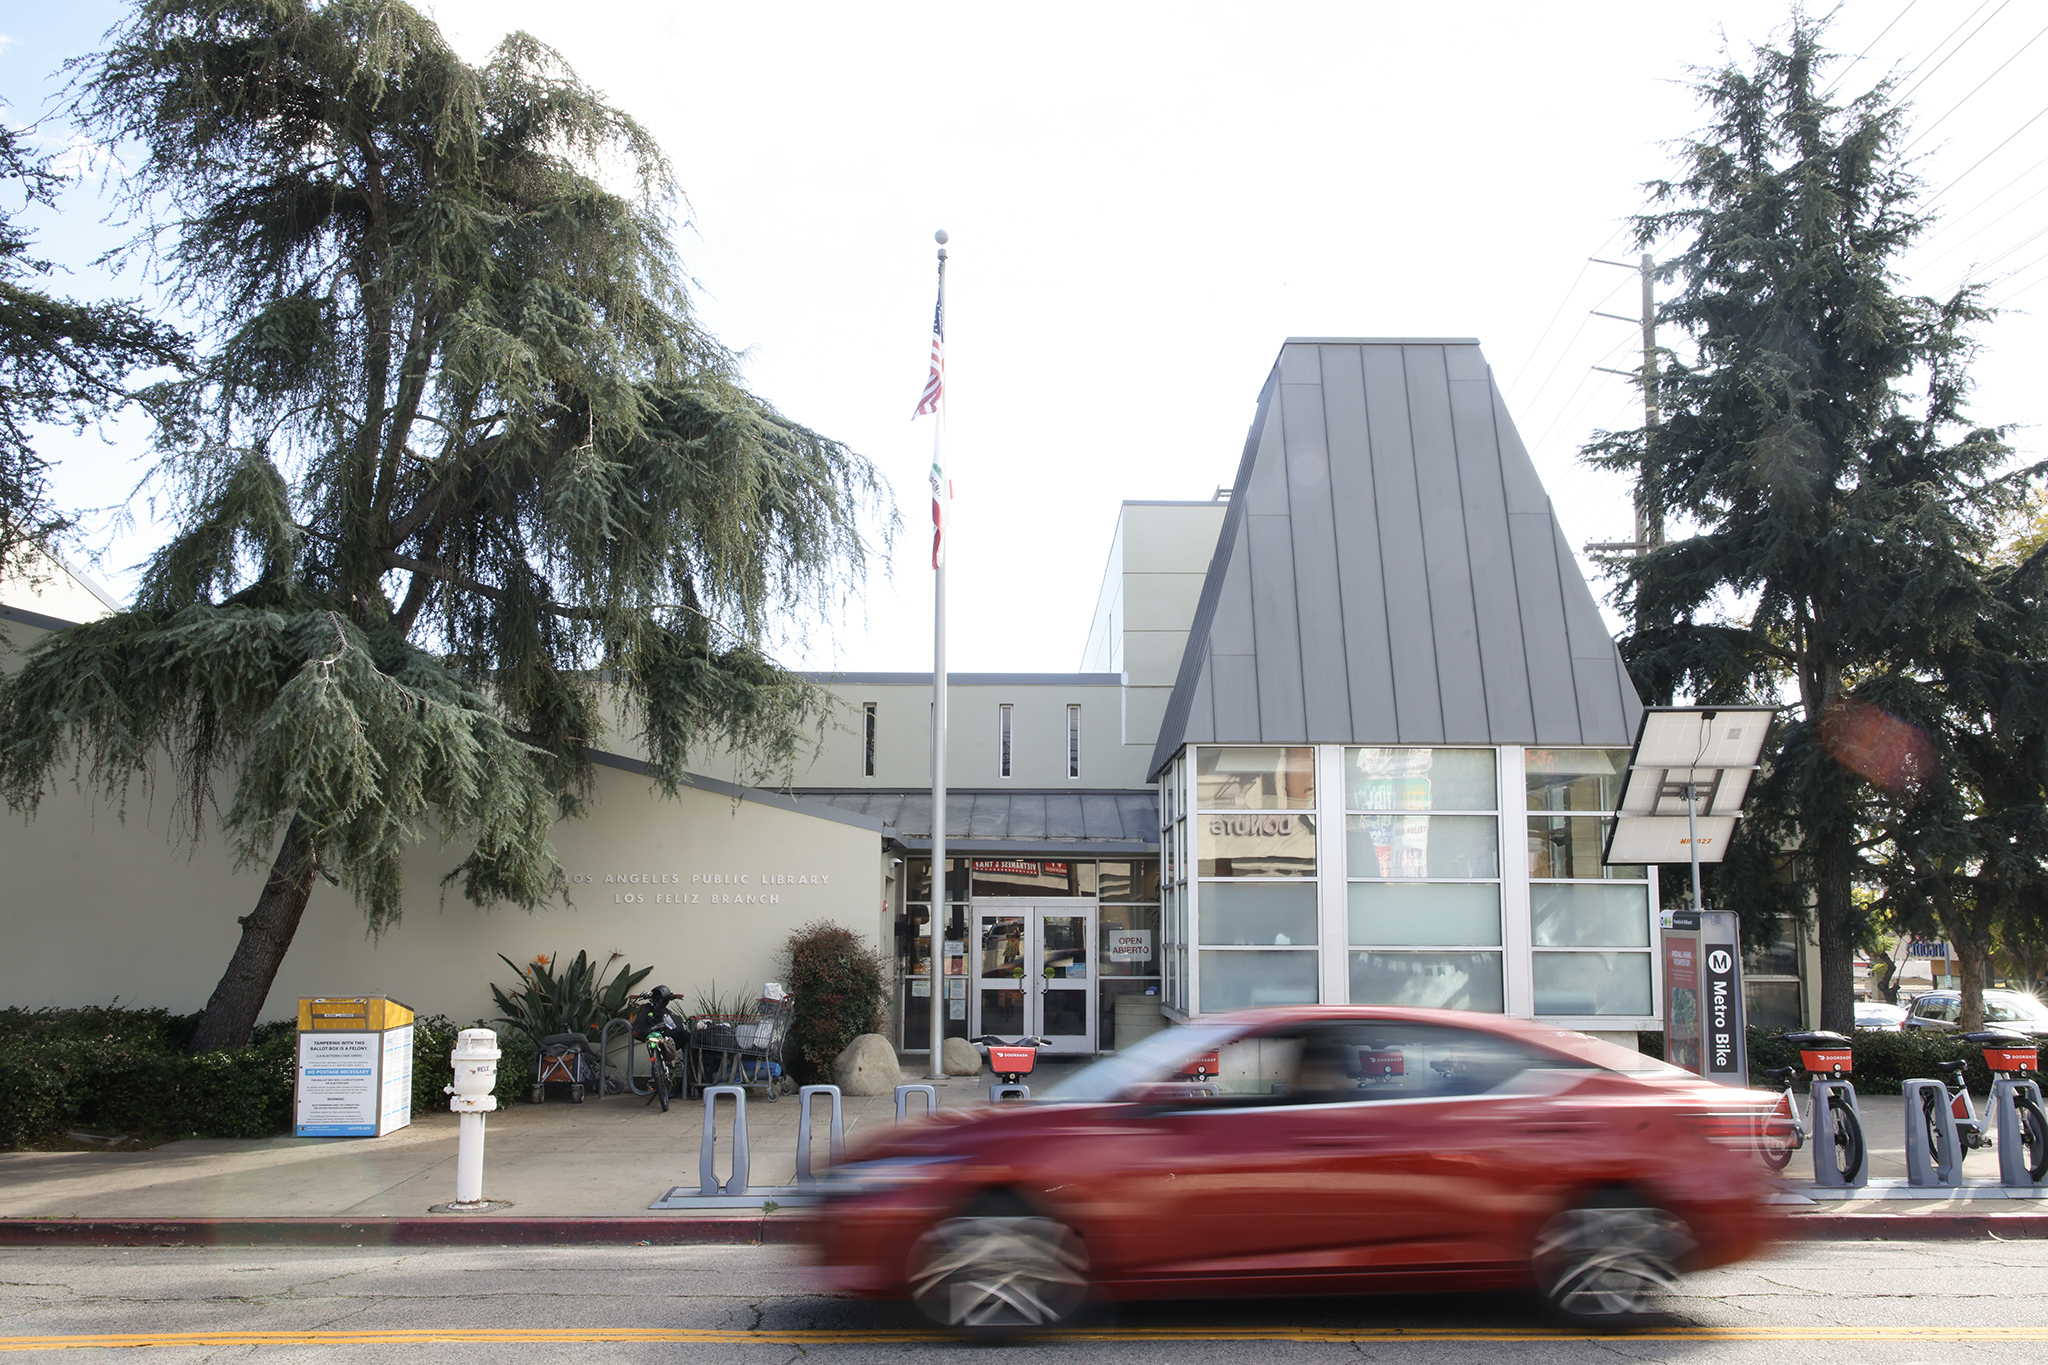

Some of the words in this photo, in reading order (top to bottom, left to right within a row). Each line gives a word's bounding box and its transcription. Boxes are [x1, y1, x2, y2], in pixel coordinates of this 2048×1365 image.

[565, 873, 593, 884] LOS
[604, 873, 679, 884] ANGELES
[692, 874, 748, 884] PUBLIC
[761, 874, 829, 885] LIBRARY
[615, 893, 644, 904] LOS
[656, 893, 699, 904] FELIZ
[711, 894, 779, 904] BRANCH
[1119, 937, 1142, 945] OPEN
[1112, 946, 1149, 954] ABIERTO
[1713, 954, 1727, 969] M
[1713, 981, 1728, 1028] Metro
[1715, 1033, 1731, 1066] Bike
